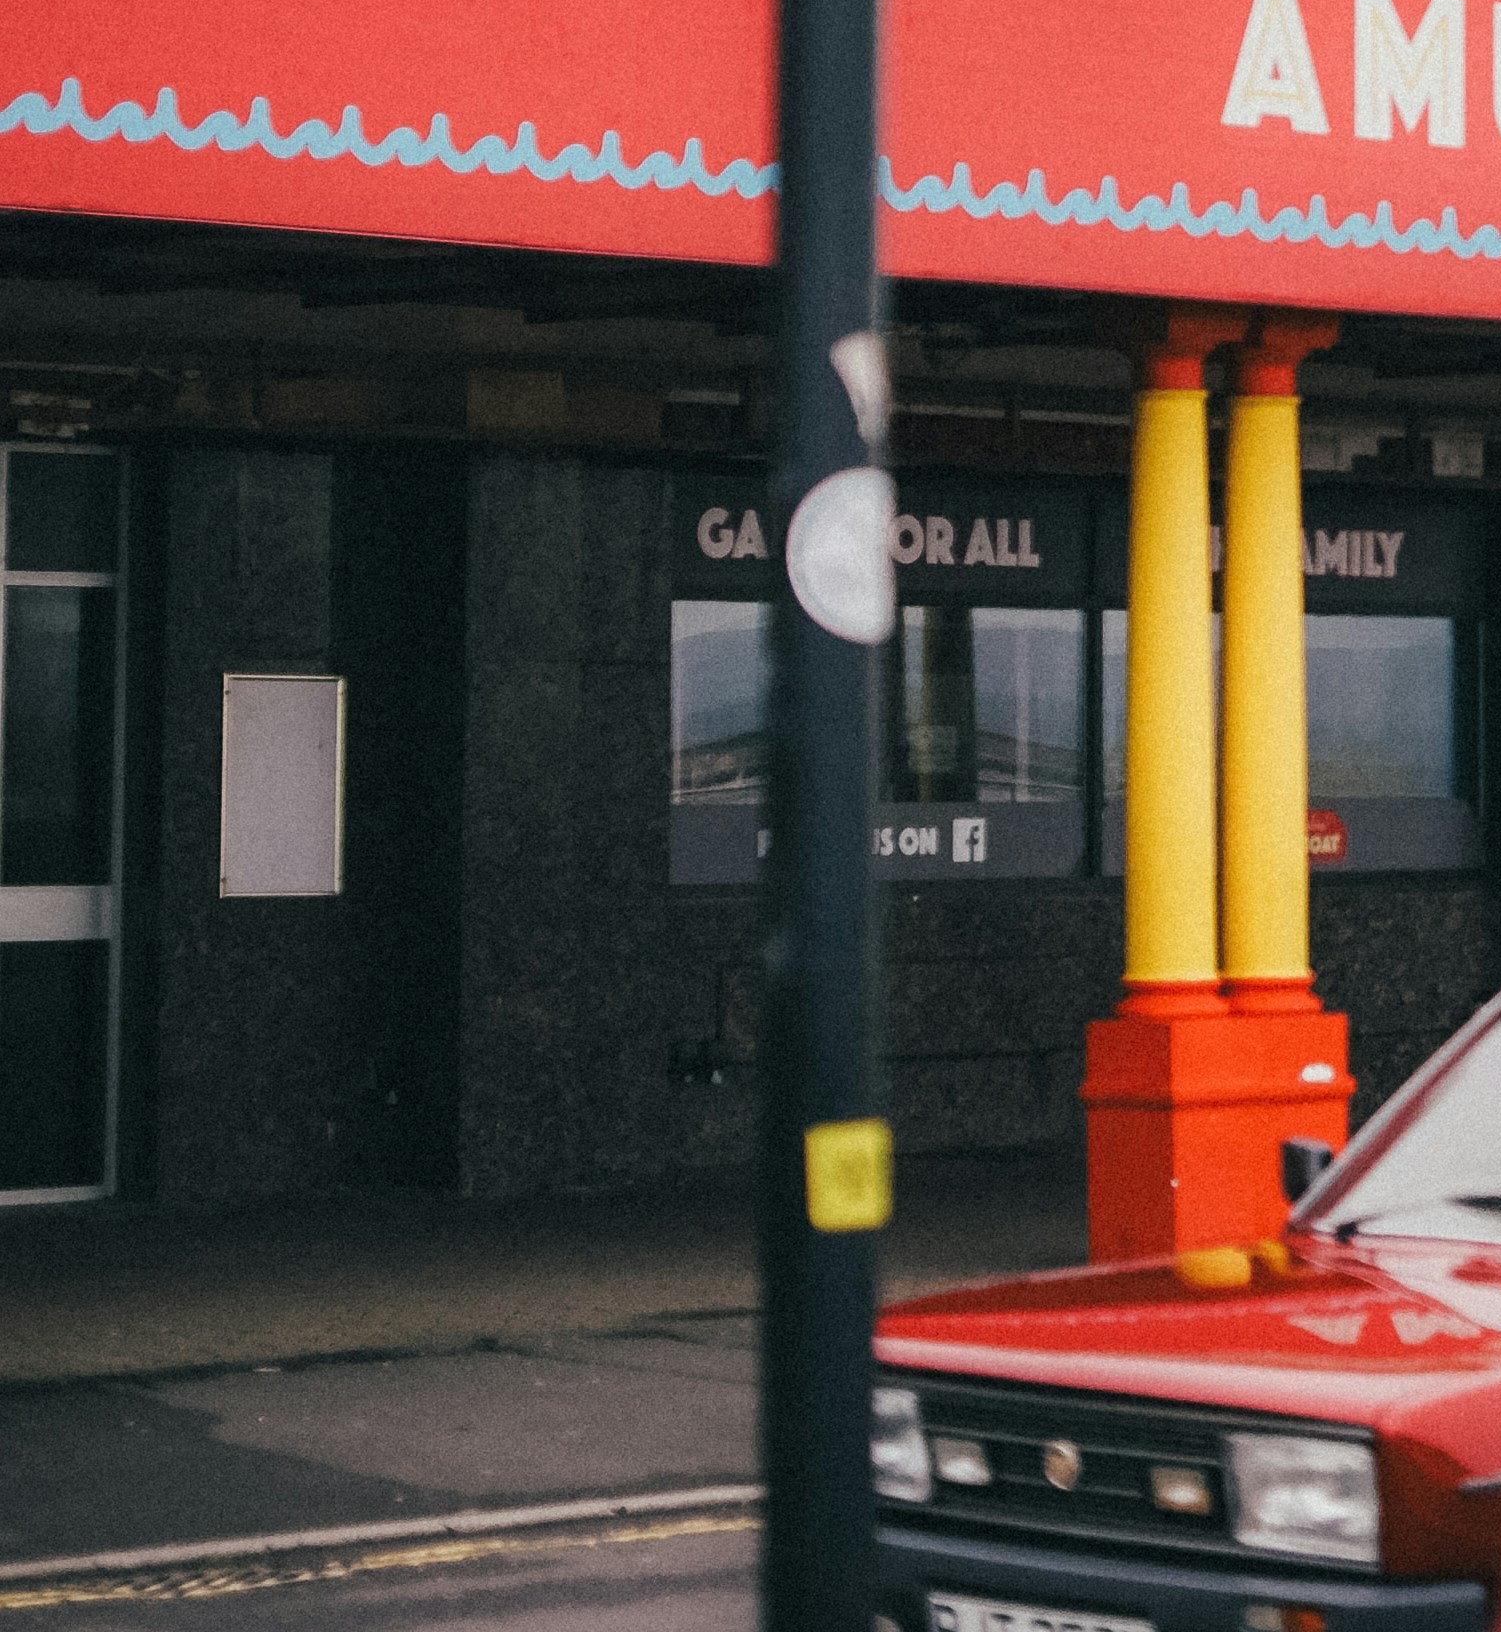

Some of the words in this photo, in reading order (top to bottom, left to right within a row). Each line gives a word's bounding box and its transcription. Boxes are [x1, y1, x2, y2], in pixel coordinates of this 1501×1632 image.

[891, 514, 955, 565] OR
[963, 517, 1040, 568] ALL
[898, 826, 938, 856] ON
